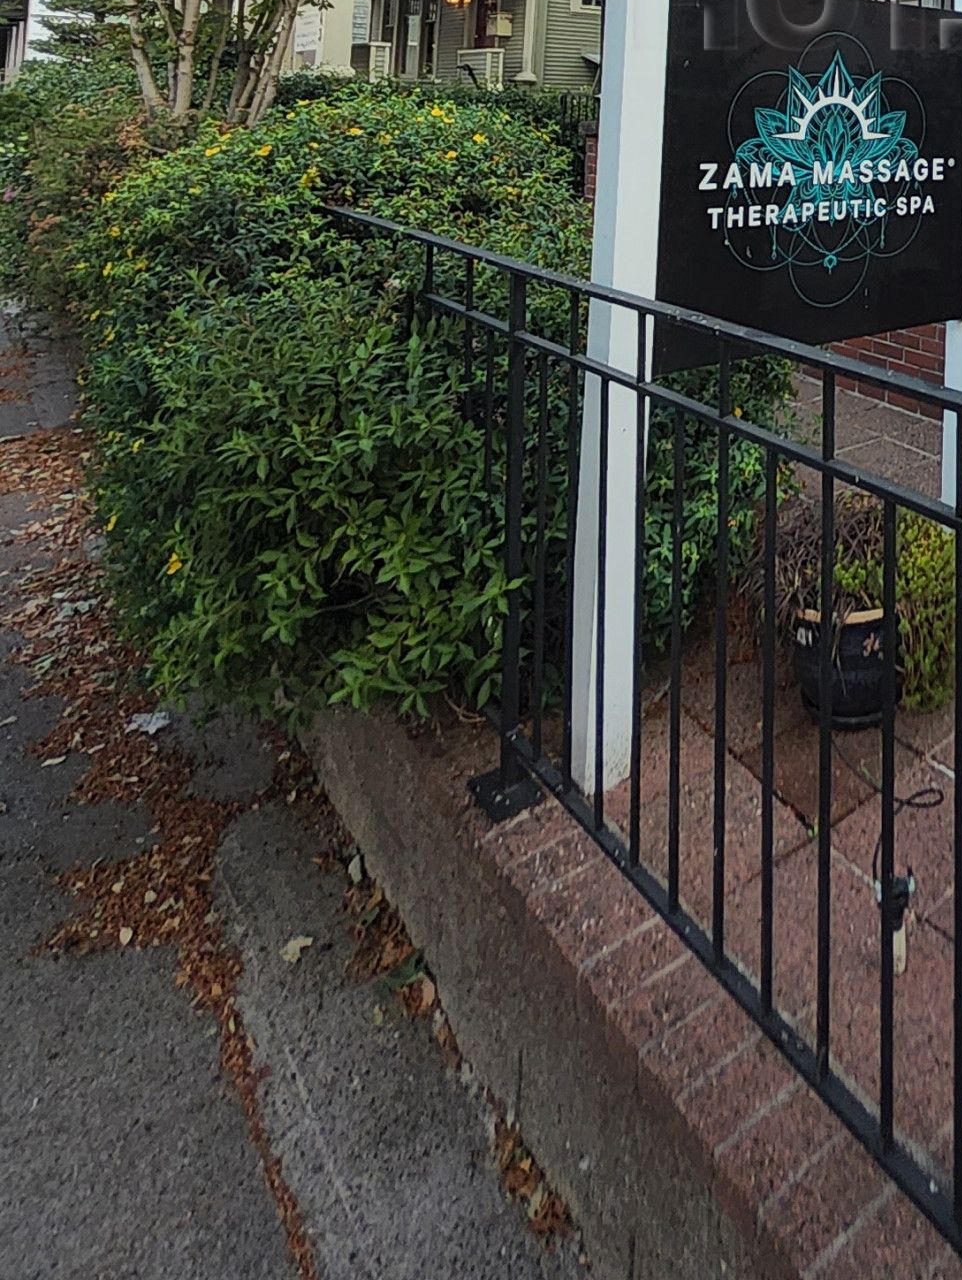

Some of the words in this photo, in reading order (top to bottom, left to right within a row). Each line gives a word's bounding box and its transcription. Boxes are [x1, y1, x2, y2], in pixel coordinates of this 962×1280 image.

[698, 161, 797, 191] ZAMA
[812, 157, 945, 185] MASSAGE
[706, 197, 887, 230] THERAPEUTIC
[896, 194, 935, 216] SPA
